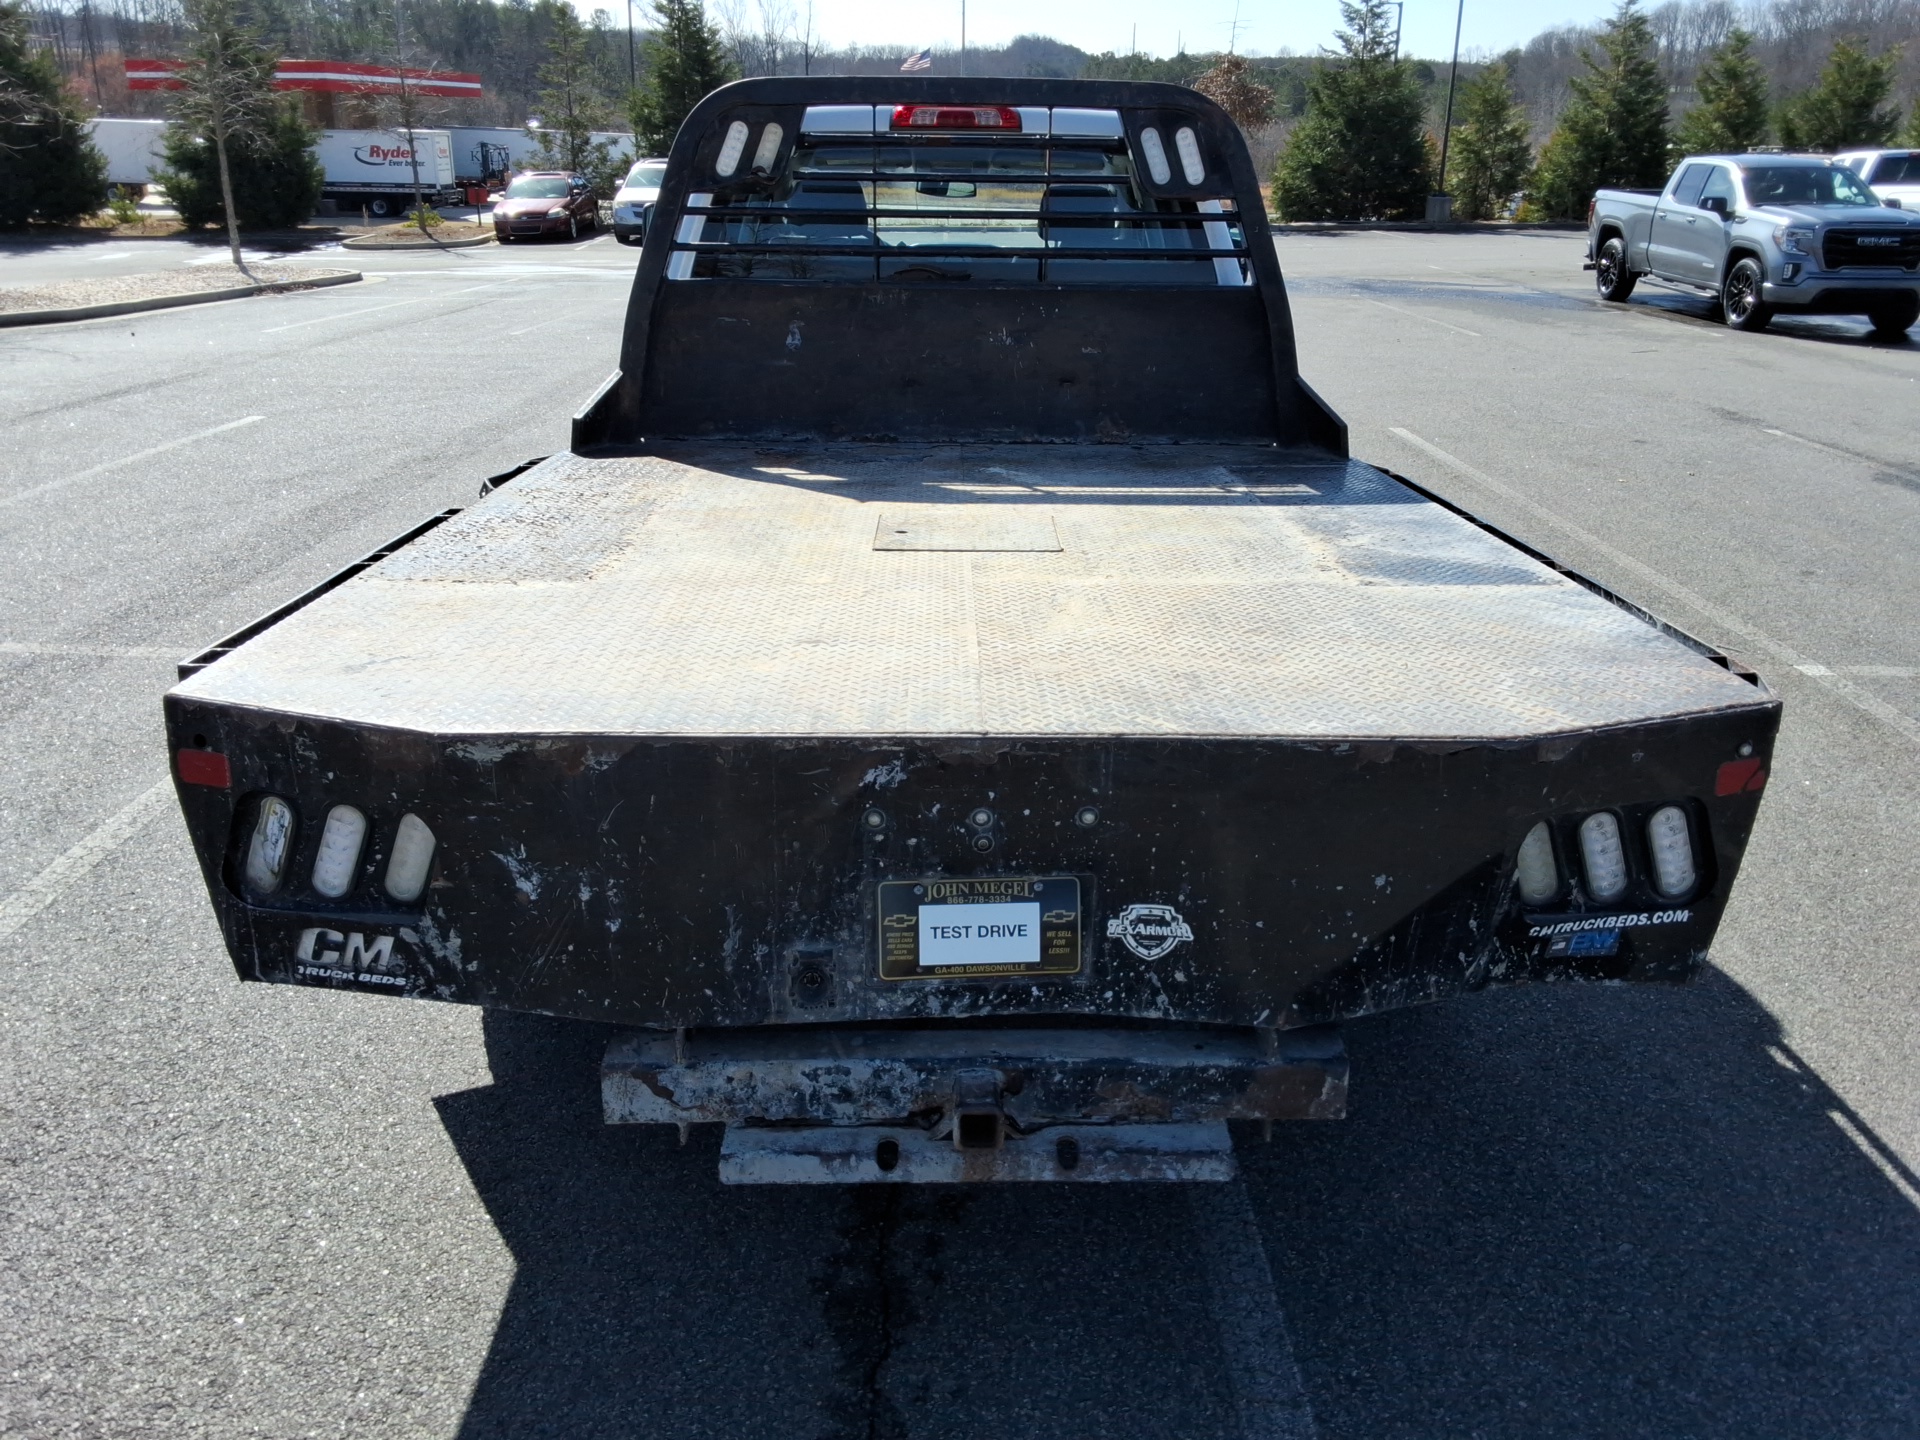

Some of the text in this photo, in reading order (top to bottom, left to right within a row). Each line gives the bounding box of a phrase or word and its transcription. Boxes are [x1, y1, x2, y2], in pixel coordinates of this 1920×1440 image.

[369, 145, 418, 161] Ryder
[389, 159, 403, 167] Ever
[1857, 237, 1901, 247] GMC
[925, 882, 1034, 902] JOHN MEGEL
[947, 895, 1011, 904] 866-778-3334
[930, 924, 1028, 940] TEST DRIVE
[297, 927, 395, 971] CM
[297, 965, 407, 986] TRUCK BEDS
[966, 964, 1026, 973] DAWSONVILLE
